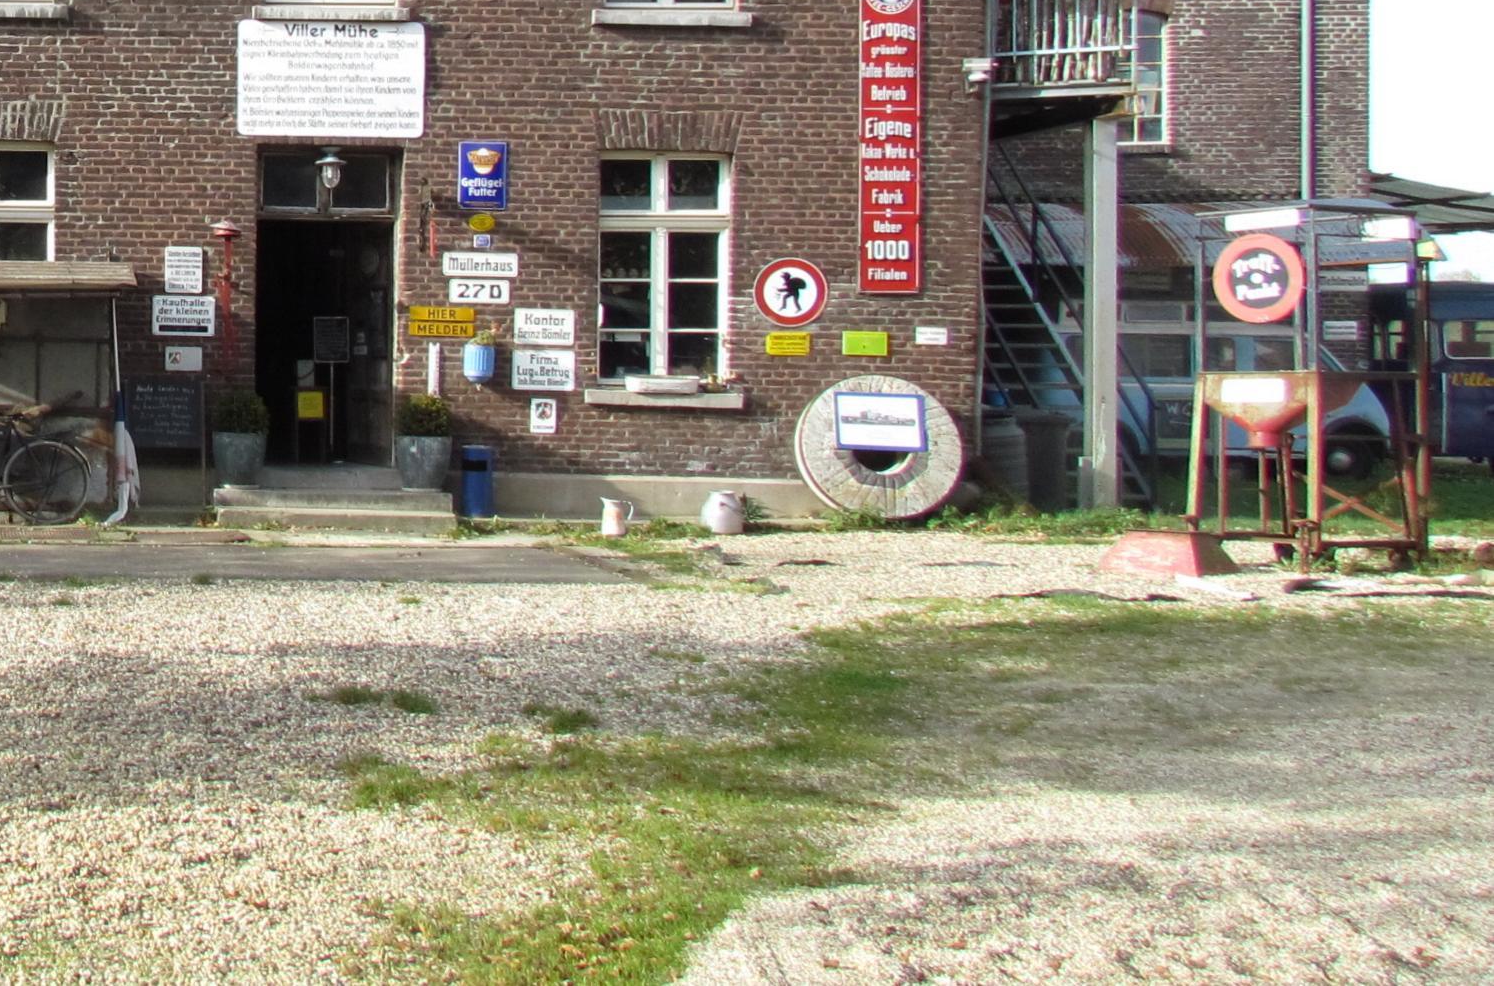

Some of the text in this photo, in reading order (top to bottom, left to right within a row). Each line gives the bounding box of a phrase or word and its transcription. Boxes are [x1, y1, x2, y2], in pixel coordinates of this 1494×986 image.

[284, 23, 326, 37] Viller
[862, 20, 916, 41] Europas
[870, 85, 907, 101] Betrieb
[865, 117, 912, 140] Eigene
[468, 187, 497, 196] Futter
[871, 188, 904, 205] Fabrik
[872, 220, 903, 233] Ueber
[865, 240, 910, 261] 1000
[448, 257, 513, 272] Müllerhaus
[867, 267, 908, 281] Filialen
[457, 283, 486, 298] 27
[162, 298, 206, 306] Kaufhalle
[158, 306, 210, 315] der kleinen
[427, 308, 456, 319] HIER
[155, 315, 212, 326] Erinnerungen
[524, 313, 566, 326] Kontor
[417, 324, 468, 335] MELDEN
[529, 354, 559, 365] Firma
[517, 365, 534, 378] Lug
[539, 366, 570, 379] Betrug
